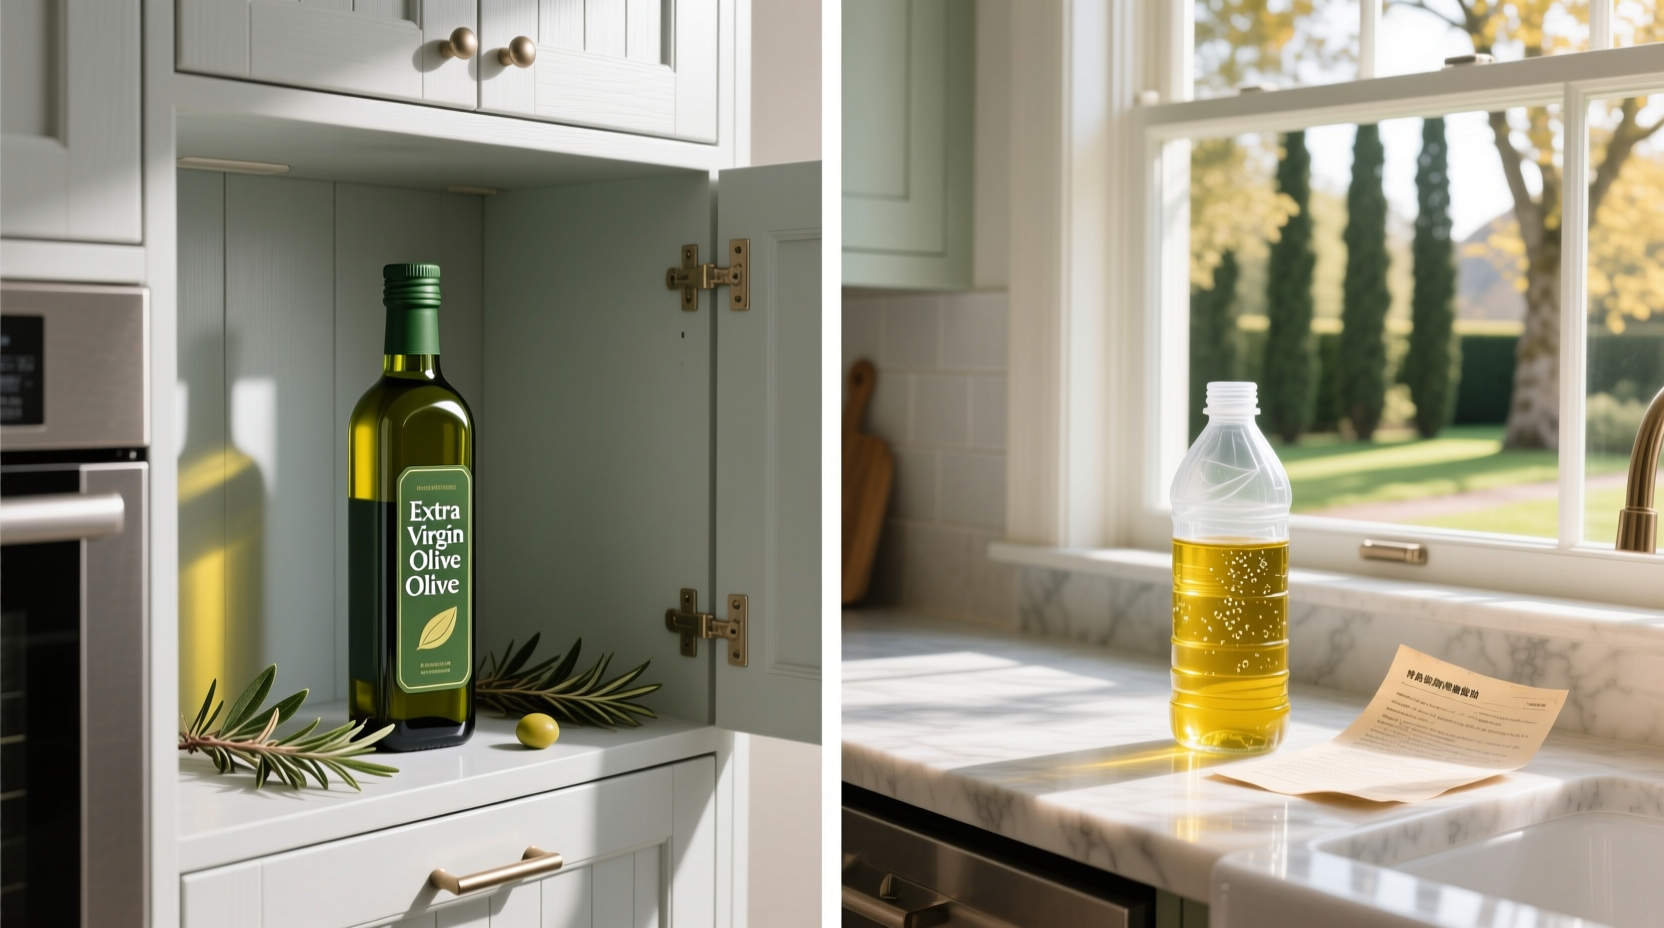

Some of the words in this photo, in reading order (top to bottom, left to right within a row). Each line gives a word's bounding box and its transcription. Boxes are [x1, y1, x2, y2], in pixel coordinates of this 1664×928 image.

[409, 500, 461, 522] Extra
[407, 524, 464, 550] Virgin
[409, 549, 461, 571] Olive
[405, 574, 460, 597] Olive
